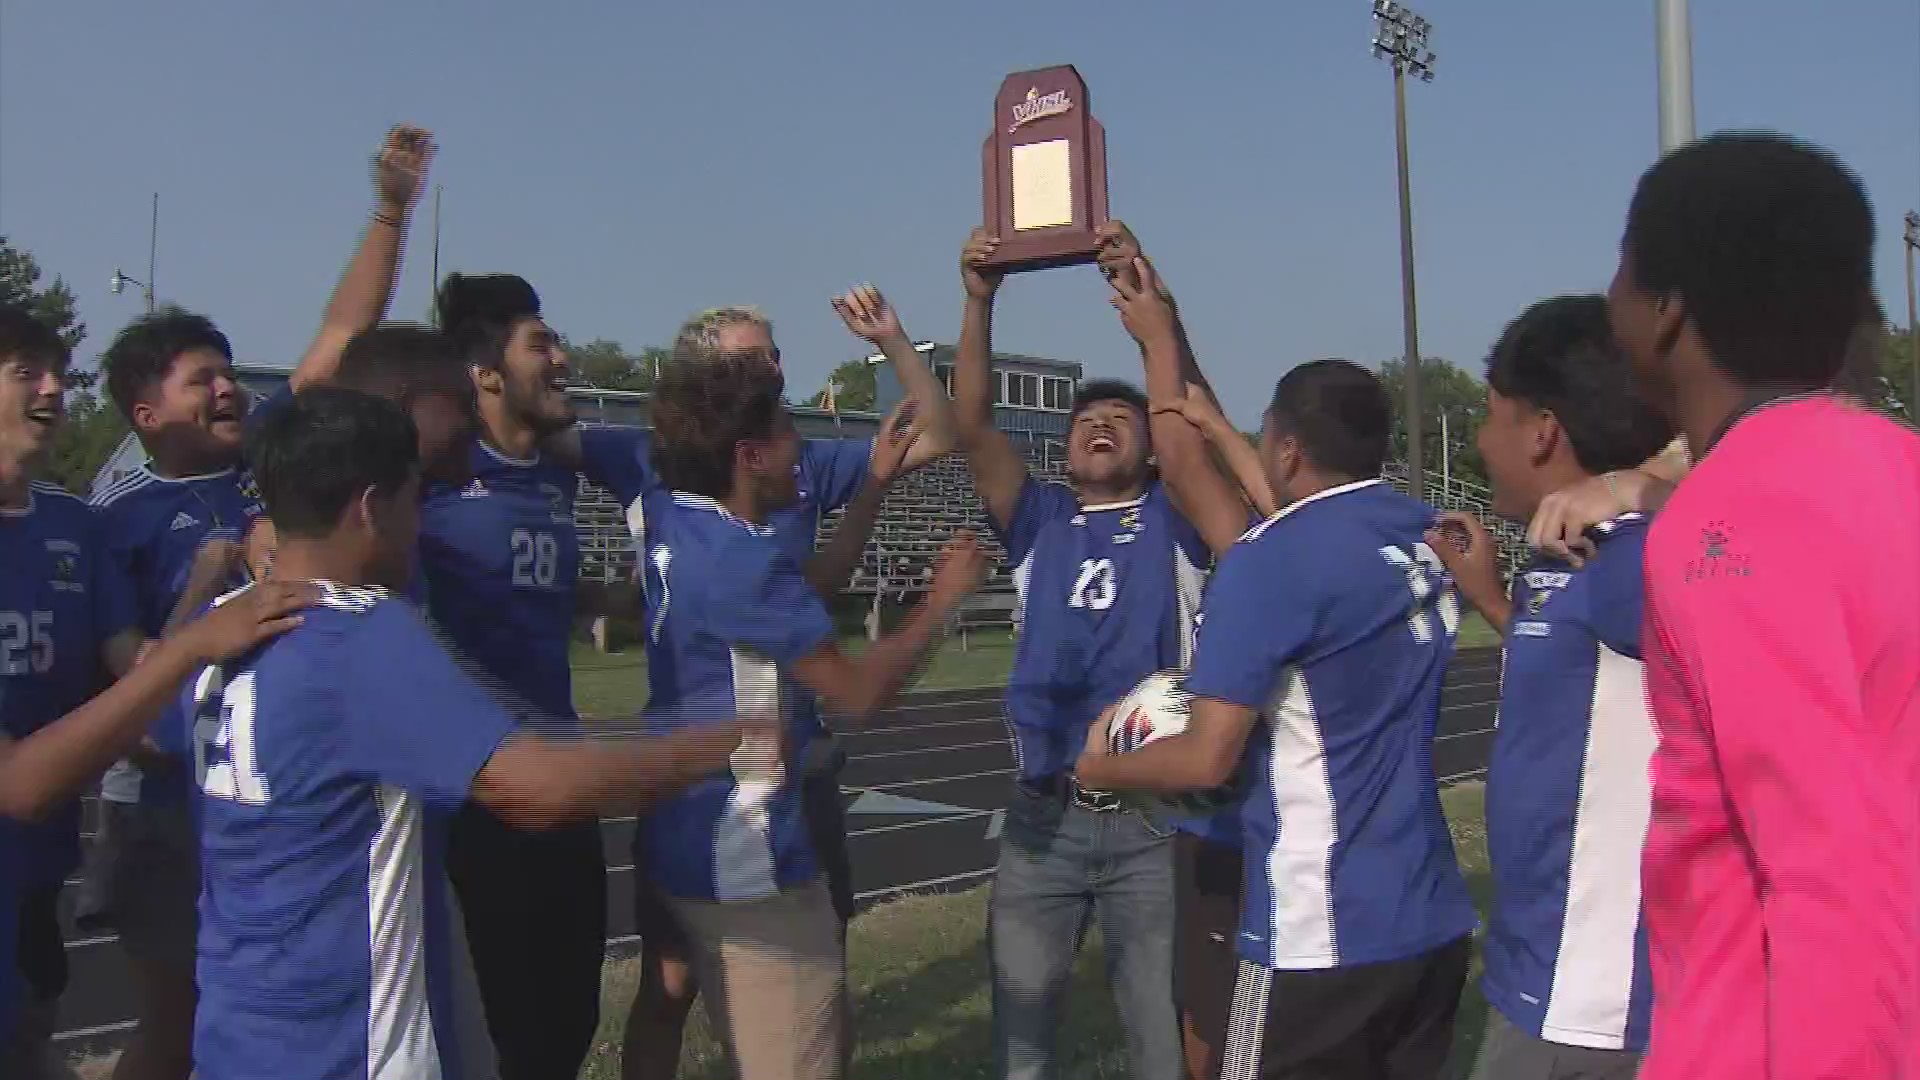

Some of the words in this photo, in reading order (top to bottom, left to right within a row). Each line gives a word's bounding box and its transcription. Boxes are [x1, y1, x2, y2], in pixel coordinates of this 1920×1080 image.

[511, 528, 557, 587] 28
[1067, 558, 1117, 611] 13
[0, 610, 54, 675] 25
[193, 664, 272, 806] 21
